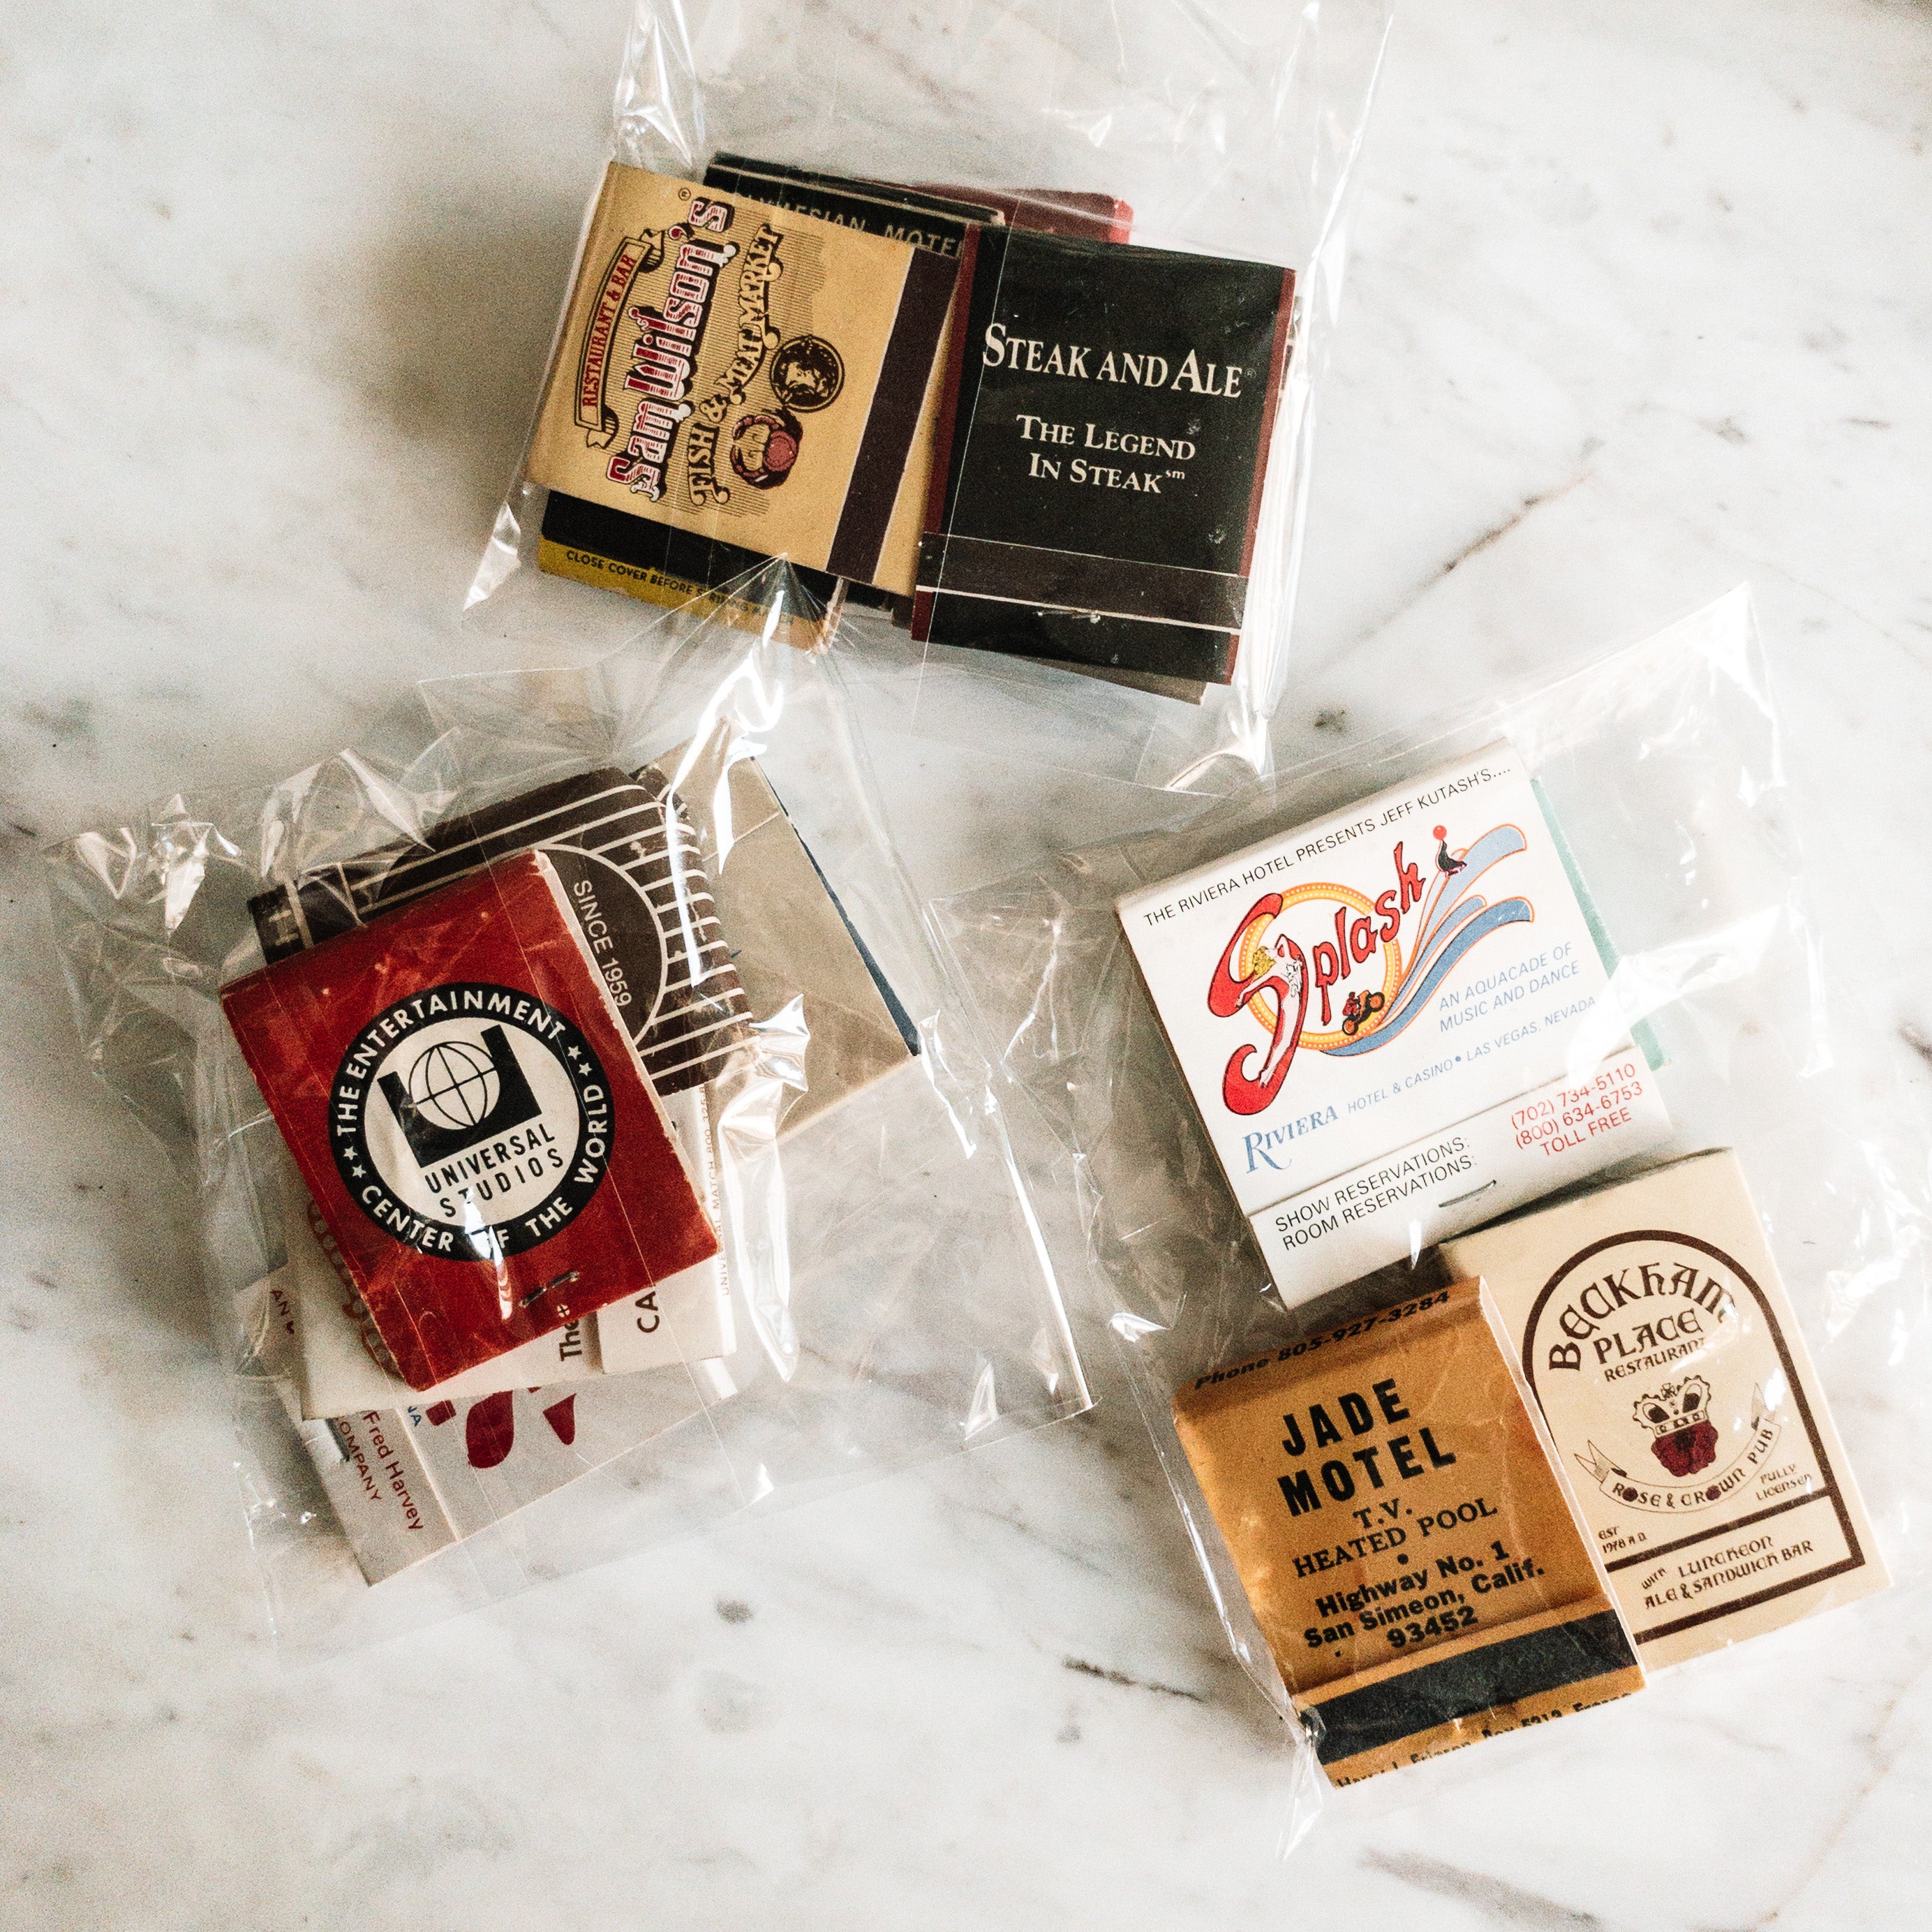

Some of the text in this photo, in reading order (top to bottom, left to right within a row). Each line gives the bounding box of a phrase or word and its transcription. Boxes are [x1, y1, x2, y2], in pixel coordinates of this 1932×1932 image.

[581, 254, 637, 408] RESTAURANT & BAR
[607, 197, 739, 503] Sam Wilson's
[688, 223, 783, 506] FISH & MEAT MARKET
[983, 323, 1242, 398] STEAK AND ALE
[1017, 415, 1196, 460] THE LEGEND
[1029, 452, 1060, 480] IN
[567, 551, 604, 570] CLOSE
[609, 563, 646, 582] COVER
[650, 574, 693, 595] BEFORE
[1143, 903, 1175, 927] THE
[1178, 877, 1240, 914] RIVIERA
[1242, 854, 1294, 889] HOTEL
[1295, 818, 1376, 862] PRESENTS
[1380, 801, 1414, 828] JEFF
[574, 879, 632, 1006] SINCE 1959
[1208, 841, 1426, 1115] Splash
[1439, 942, 1571, 1011] AN AQUACADE OF
[1440, 960, 1580, 1032] MUSIC AND DANCE
[337, 990, 565, 1136] THE ENTERTAINMENT
[1242, 1106, 1339, 1175] RIVIERA
[1347, 1088, 1389, 1114] HOTEL
[1392, 1083, 1402, 1094] &
[1404, 1059, 1453, 1088] CASINO
[1466, 1042, 1491, 1062] LAS
[1544, 996, 1596, 1027] NEVADA
[1511, 1063, 1635, 1130] (702) 734-5110
[1516, 1081, 1642, 1150] (800) 634-6753
[1540, 1107, 1632, 1156] TOLL FREE
[362, 1184, 454, 1252] CENTER
[525, 1196, 573, 1238] THE
[574, 1084, 608, 1185] WORLD
[424, 1123, 555, 1193] UNIVERSAL
[708, 1161, 720, 1210] MATCH
[1275, 1136, 1470, 1232] SHOW RESERVATIONS:
[1282, 1154, 1477, 1251] ROOM RESERVATIONS:
[1194, 1291, 1448, 1390] Phone 805-927-3284
[1548, 1262, 1736, 1372] BECKHAM
[1593, 1307, 1703, 1365] PLACE
[1605, 1337, 1705, 1382] RESTAURANT
[1281, 1377, 1410, 1457] JADE
[335, 1418, 382, 1500] OMPANY
[362, 1411, 424, 1530] Fred Harvey
[1277, 1427, 1457, 1517] MOTEL
[1666, 1493, 1675, 1508] &
[1746, 1429, 1774, 1464] PUB
[1293, 1497, 1498, 1578] HEATED POOL
[1353, 1498, 1413, 1529] T.V.
[1315, 1540, 1510, 1619] Highway No. 1
[1644, 1539, 1814, 1610] ALE & SANDWICH BAR
[1678, 1535, 1774, 1578] LUNCHEON
[1303, 1557, 1545, 1648] San Simeon, Calif.
[1386, 1605, 1479, 1648] 93452
